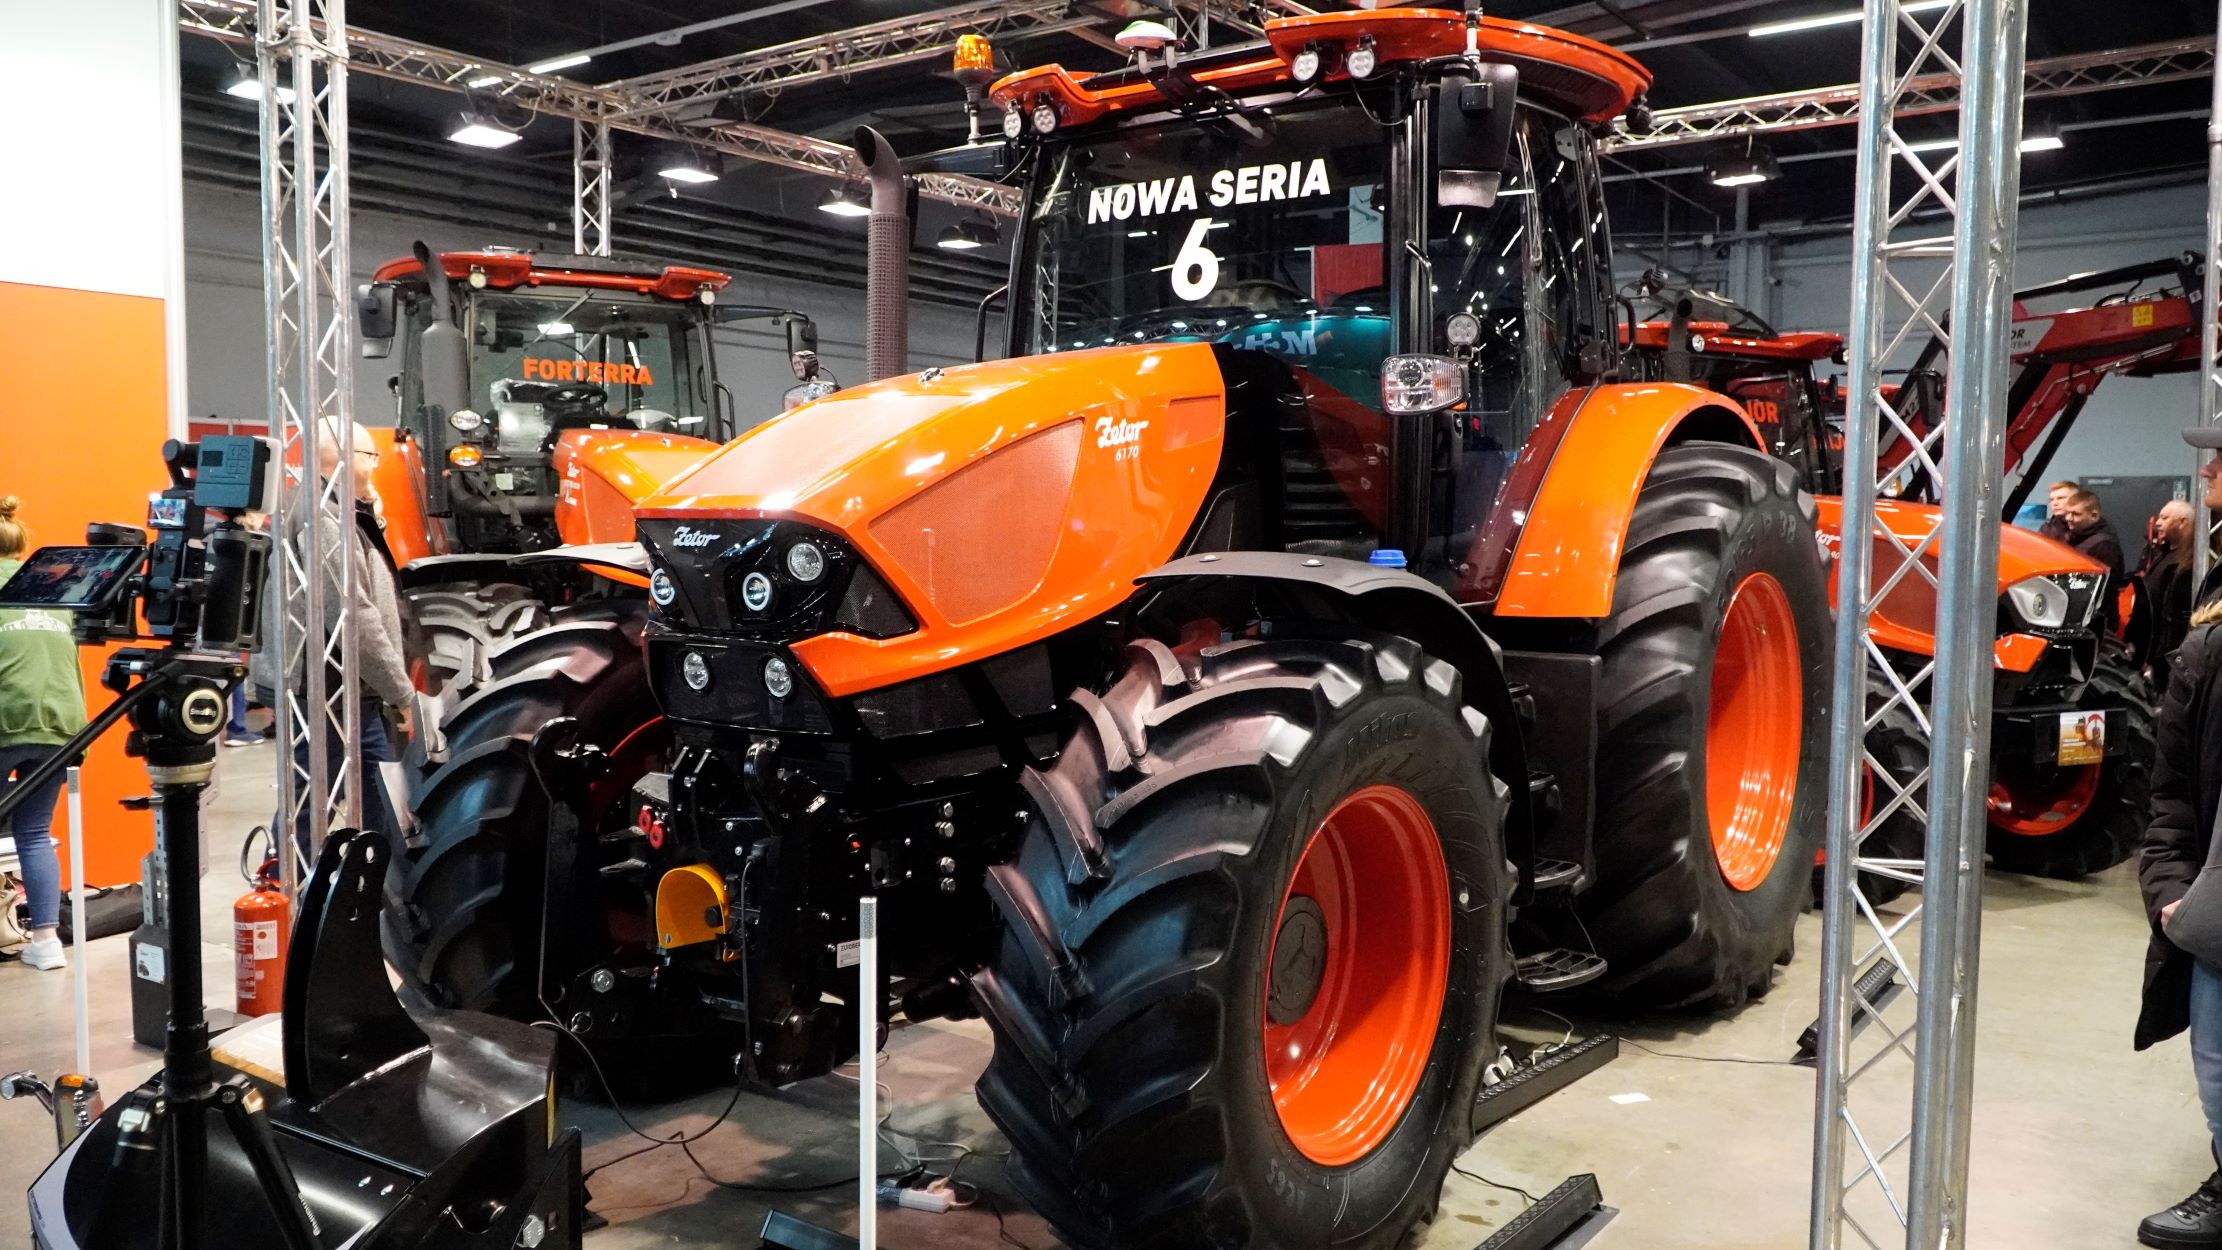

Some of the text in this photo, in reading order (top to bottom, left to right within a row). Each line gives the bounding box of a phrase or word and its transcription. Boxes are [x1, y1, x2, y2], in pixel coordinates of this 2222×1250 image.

[1087, 158, 1332, 225] NOWA SERIA
[1170, 217, 1220, 302] 6
[523, 357, 654, 386] FORTERRA
[1094, 415, 1149, 449] Zetor
[1115, 445, 1139, 462] 6170
[672, 525, 721, 547] Zetor
